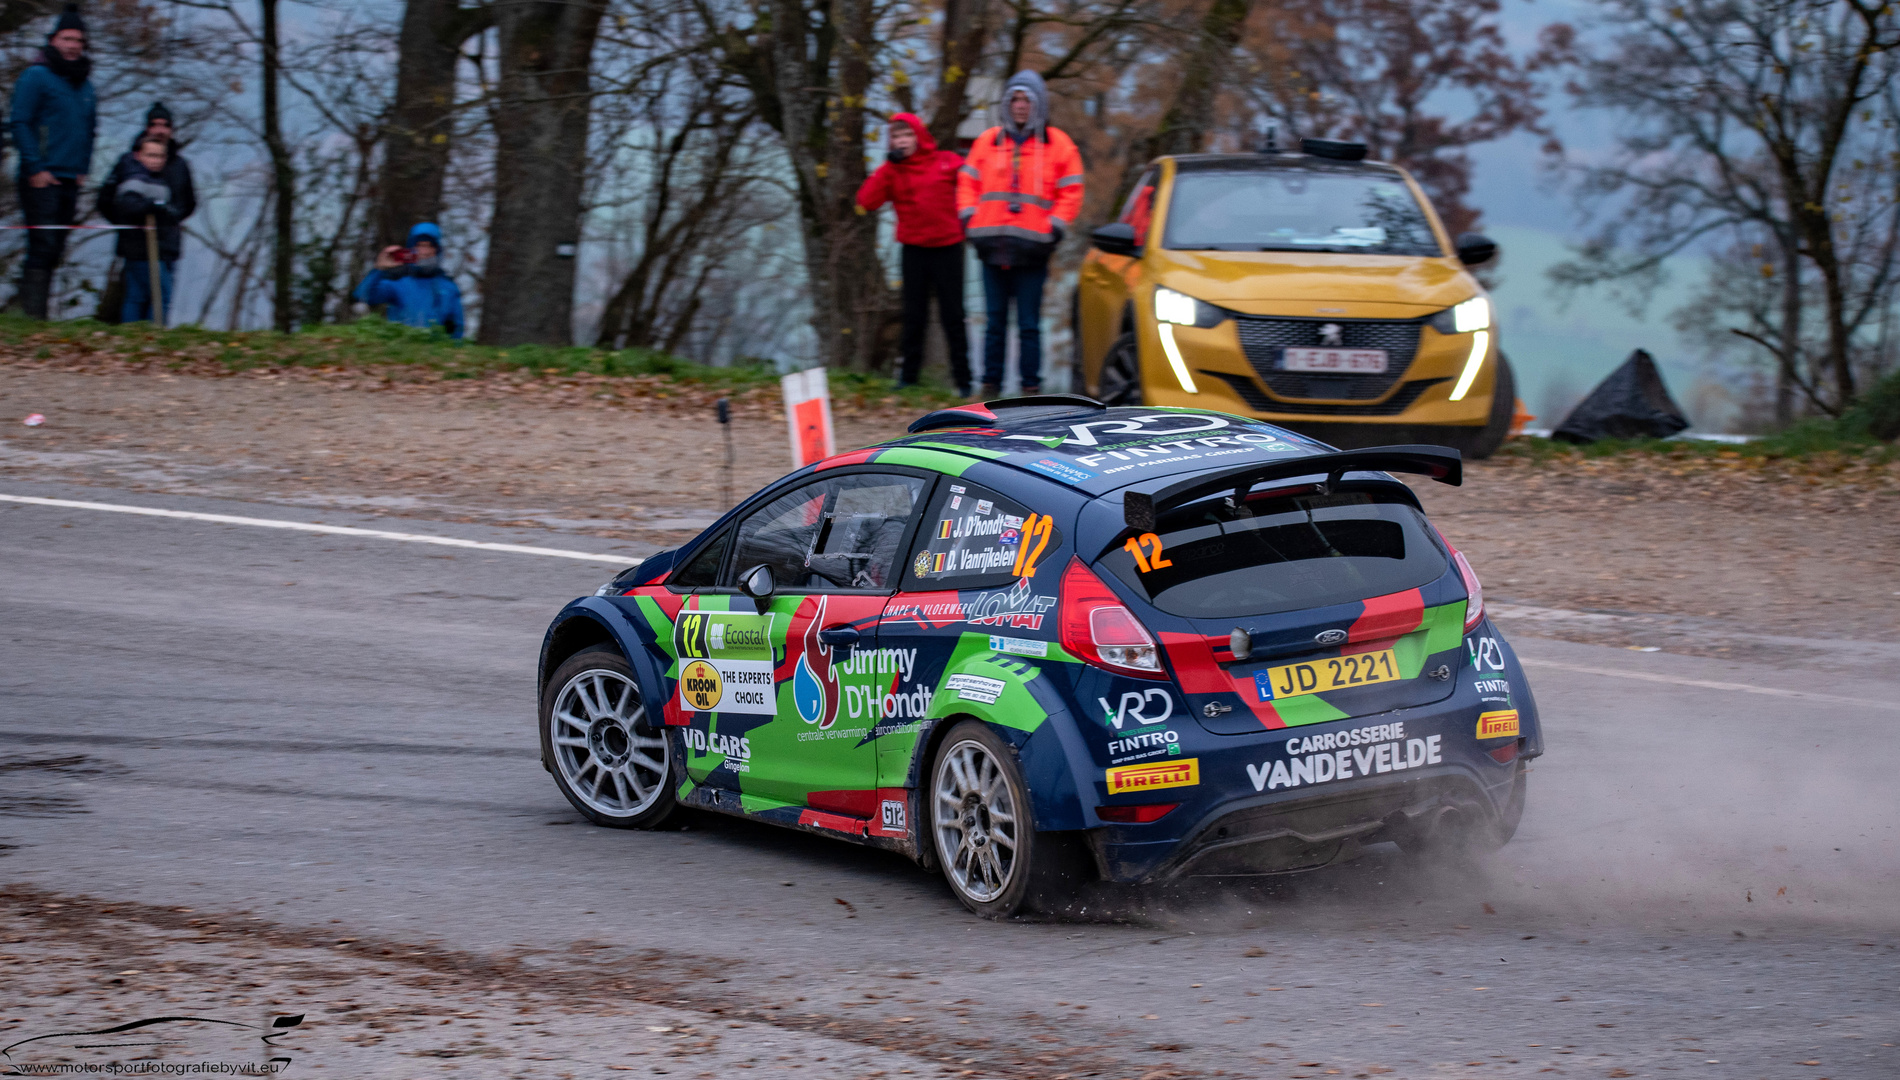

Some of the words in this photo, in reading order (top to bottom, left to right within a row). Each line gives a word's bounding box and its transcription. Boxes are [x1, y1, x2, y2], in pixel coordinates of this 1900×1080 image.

[1001, 414, 1229, 446] VRD
[1075, 433, 1276, 467] FINTRO
[1103, 464, 1135, 475] BNP
[1138, 454, 1203, 467] PARIBAS
[1205, 447, 1255, 457] GROEP
[953, 517, 963, 538] J.
[965, 514, 1005, 537] D'hondt
[1012, 513, 1053, 578] 12
[1123, 532, 1173, 573] 12
[946, 550, 957, 571] D.
[960, 546, 1016, 574] Vanrijkelen
[882, 604, 909, 616] CHAPE
[912, 606, 918, 616] &
[968, 590, 1057, 630] LOMAT
[683, 615, 703, 658] 12
[725, 624, 765, 645] Ecostal
[1322, 631, 1341, 643] Ford
[843, 642, 917, 682] Jimmy
[1467, 637, 1505, 671] VRD
[687, 678, 717, 692] KROON
[722, 671, 736, 683] THE
[1280, 664, 1317, 695] JD
[1328, 652, 1394, 687] 2221
[1474, 680, 1510, 693] FINTRO
[695, 692, 710, 706] OIL
[735, 691, 764, 705] CHOICE
[845, 684, 932, 719] D'Hondt
[1262, 687, 1271, 698] L
[1098, 688, 1173, 729] VRD
[797, 729, 825, 742] centrale
[825, 725, 868, 740] verwarming
[1481, 714, 1518, 734] PIRELLI
[682, 727, 751, 759] VD.CARS
[1107, 730, 1178, 755] FINTRO
[1286, 722, 1404, 755] CARROSSERIE
[724, 760, 750, 773] Gingelom
[1114, 764, 1190, 789] PIRELLI
[1246, 734, 1442, 792] VANDEVELDE
